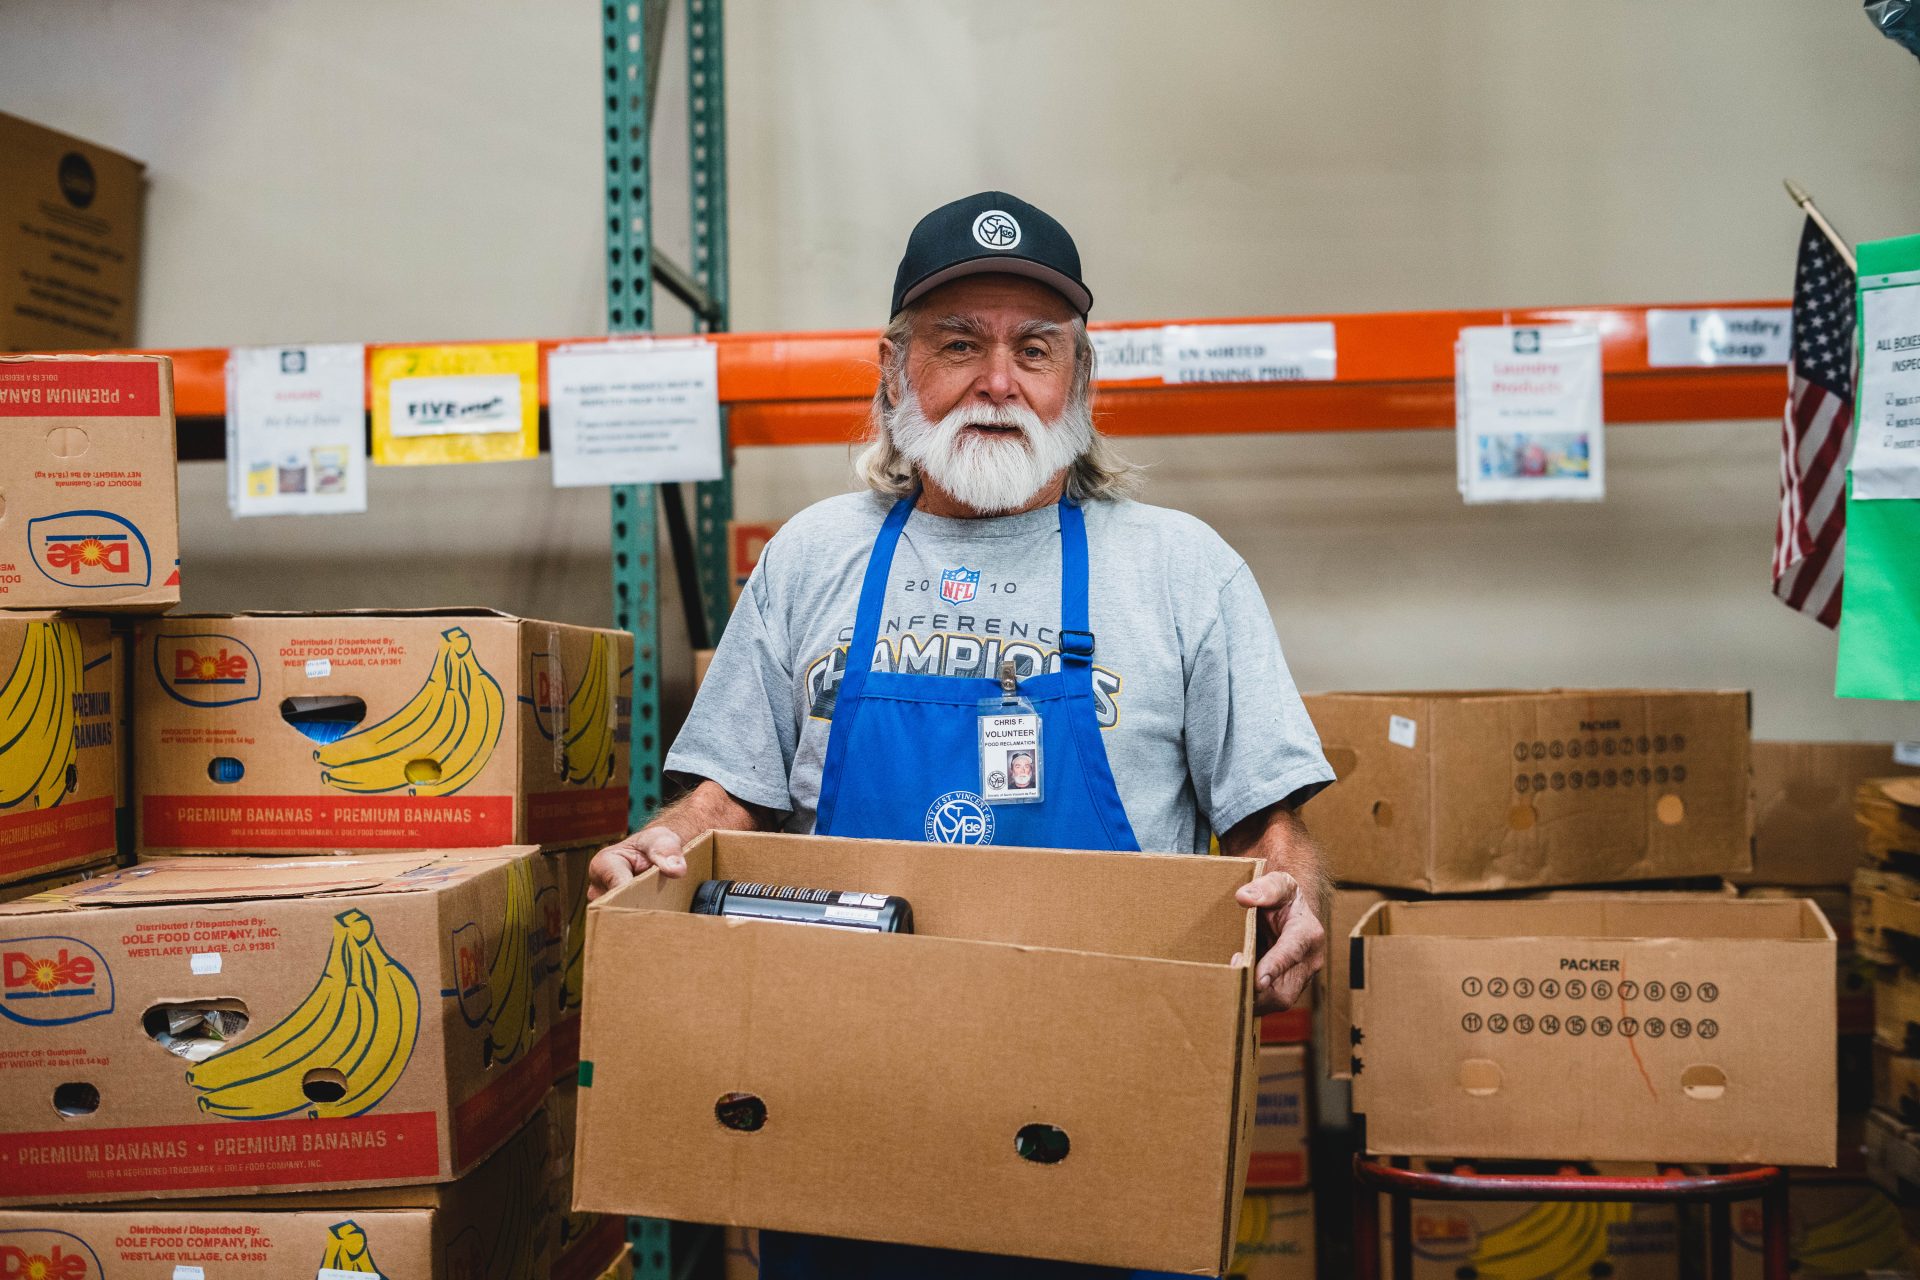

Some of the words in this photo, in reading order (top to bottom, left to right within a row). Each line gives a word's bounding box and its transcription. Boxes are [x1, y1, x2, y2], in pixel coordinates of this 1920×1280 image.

[1690, 318, 1780, 337] Lndry
[1877, 339, 1892, 351] ALL
[47, 388, 120, 404] PREMIUM
[408, 402, 457, 417] FIVE
[47, 539, 130, 575] Dole
[904, 580, 930, 592] 20
[990, 582, 1018, 594] 10
[943, 580, 977, 600] NFL
[838, 614, 1054, 645] CNFERENC
[339, 638, 382, 646] Dispatched
[383, 638, 395, 646] By:
[280, 648, 305, 656] DOLE
[307, 648, 334, 656] FOOD
[336, 646, 386, 656] COMPANY,
[387, 646, 407, 655] INC.
[174, 648, 248, 680] Dole
[330, 658, 366, 666] VILLAGE,
[72, 692, 111, 718] PREMIUM
[74, 722, 112, 750] BANANAS
[985, 730, 1034, 738] VOLUNTEER
[956, 793, 989, 812] VINCENT
[177, 808, 242, 822] PREMIUM
[247, 808, 313, 822] BANANAS
[333, 808, 400, 822] PREMIUM
[404, 808, 472, 822] BANANAS
[136, 922, 188, 932] Distributed
[196, 919, 249, 930] Dispatched
[251, 917, 266, 927] By:
[122, 933, 154, 945] DOLE
[157, 932, 190, 943] FOOD
[194, 929, 254, 942] COMPANY,
[258, 927, 281, 938] INC.
[128, 946, 182, 958] WESTLAKE
[185, 944, 231, 954] VILLAGE,
[233, 943, 247, 952] CA
[249, 942, 275, 952] 91361
[3, 949, 95, 992] Dole
[1560, 958, 1620, 972] PACKER
[47, 1048, 87, 1057] Guatemala
[10, 1060, 46, 1069] WEIGHT:
[97, 1057, 110, 1066] kg)
[19, 1144, 100, 1165] PREMIUM
[105, 1140, 188, 1162] BANANAS
[214, 1134, 296, 1156] PREMIUM
[302, 1130, 387, 1151] BANANAS
[123, 1167, 167, 1177] REGISTERED
[169, 1165, 215, 1175] TRADEMARK
[245, 1162, 264, 1171] FOOD
[266, 1160, 306, 1170] COMPANY,
[130, 1225, 182, 1235] Distributed
[190, 1225, 242, 1236] Dispatched
[244, 1226, 260, 1236] By:
[115, 1238, 147, 1248] DOLE
[150, 1238, 183, 1248] FOOD
[186, 1238, 248, 1249] COMPANY,
[250, 1238, 274, 1248] INC.
[0, 1245, 88, 1280] Dole
[121, 1252, 175, 1262] WESTLAKE
[177, 1252, 223, 1262] VILLAGE,
[225, 1252, 239, 1262] CA
[240, 1252, 267, 1262] 91361
